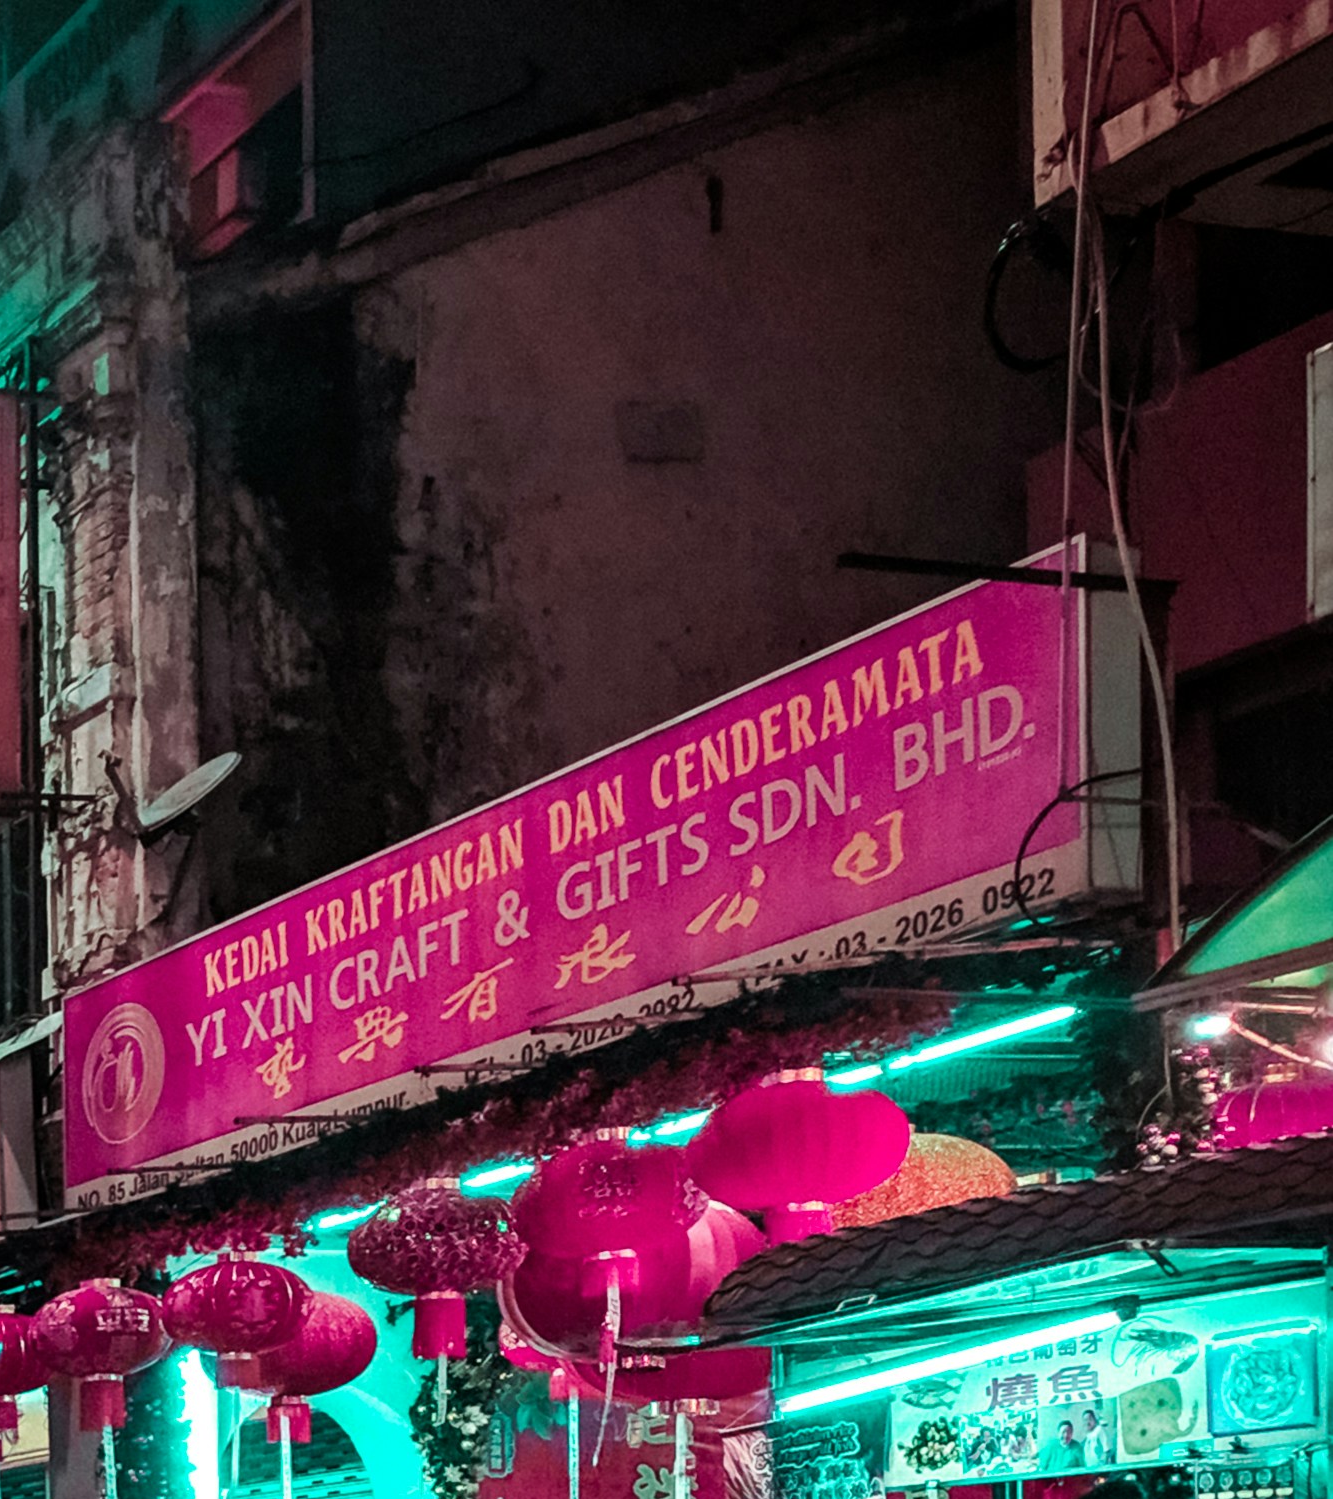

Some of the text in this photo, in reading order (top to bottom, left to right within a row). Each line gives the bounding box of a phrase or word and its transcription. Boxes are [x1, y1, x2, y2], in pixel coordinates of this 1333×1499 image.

[203, 619, 984, 997] KEDAI KRAFTANGAN DAN CENDERAMATA
[185, 684, 1035, 1067] YI XIN CRAFT & GIFTS SDN. BHD.
[894, 898, 964, 945] 2026
[981, 867, 1056, 914] 0922
[521, 1039, 547, 1066] 03
[108, 1181, 126, 1203] 85
[129, 1171, 171, 1197] Jalan
[230, 1125, 279, 1162] 50000
[986, 1364, 1103, 1412] 燒魚
